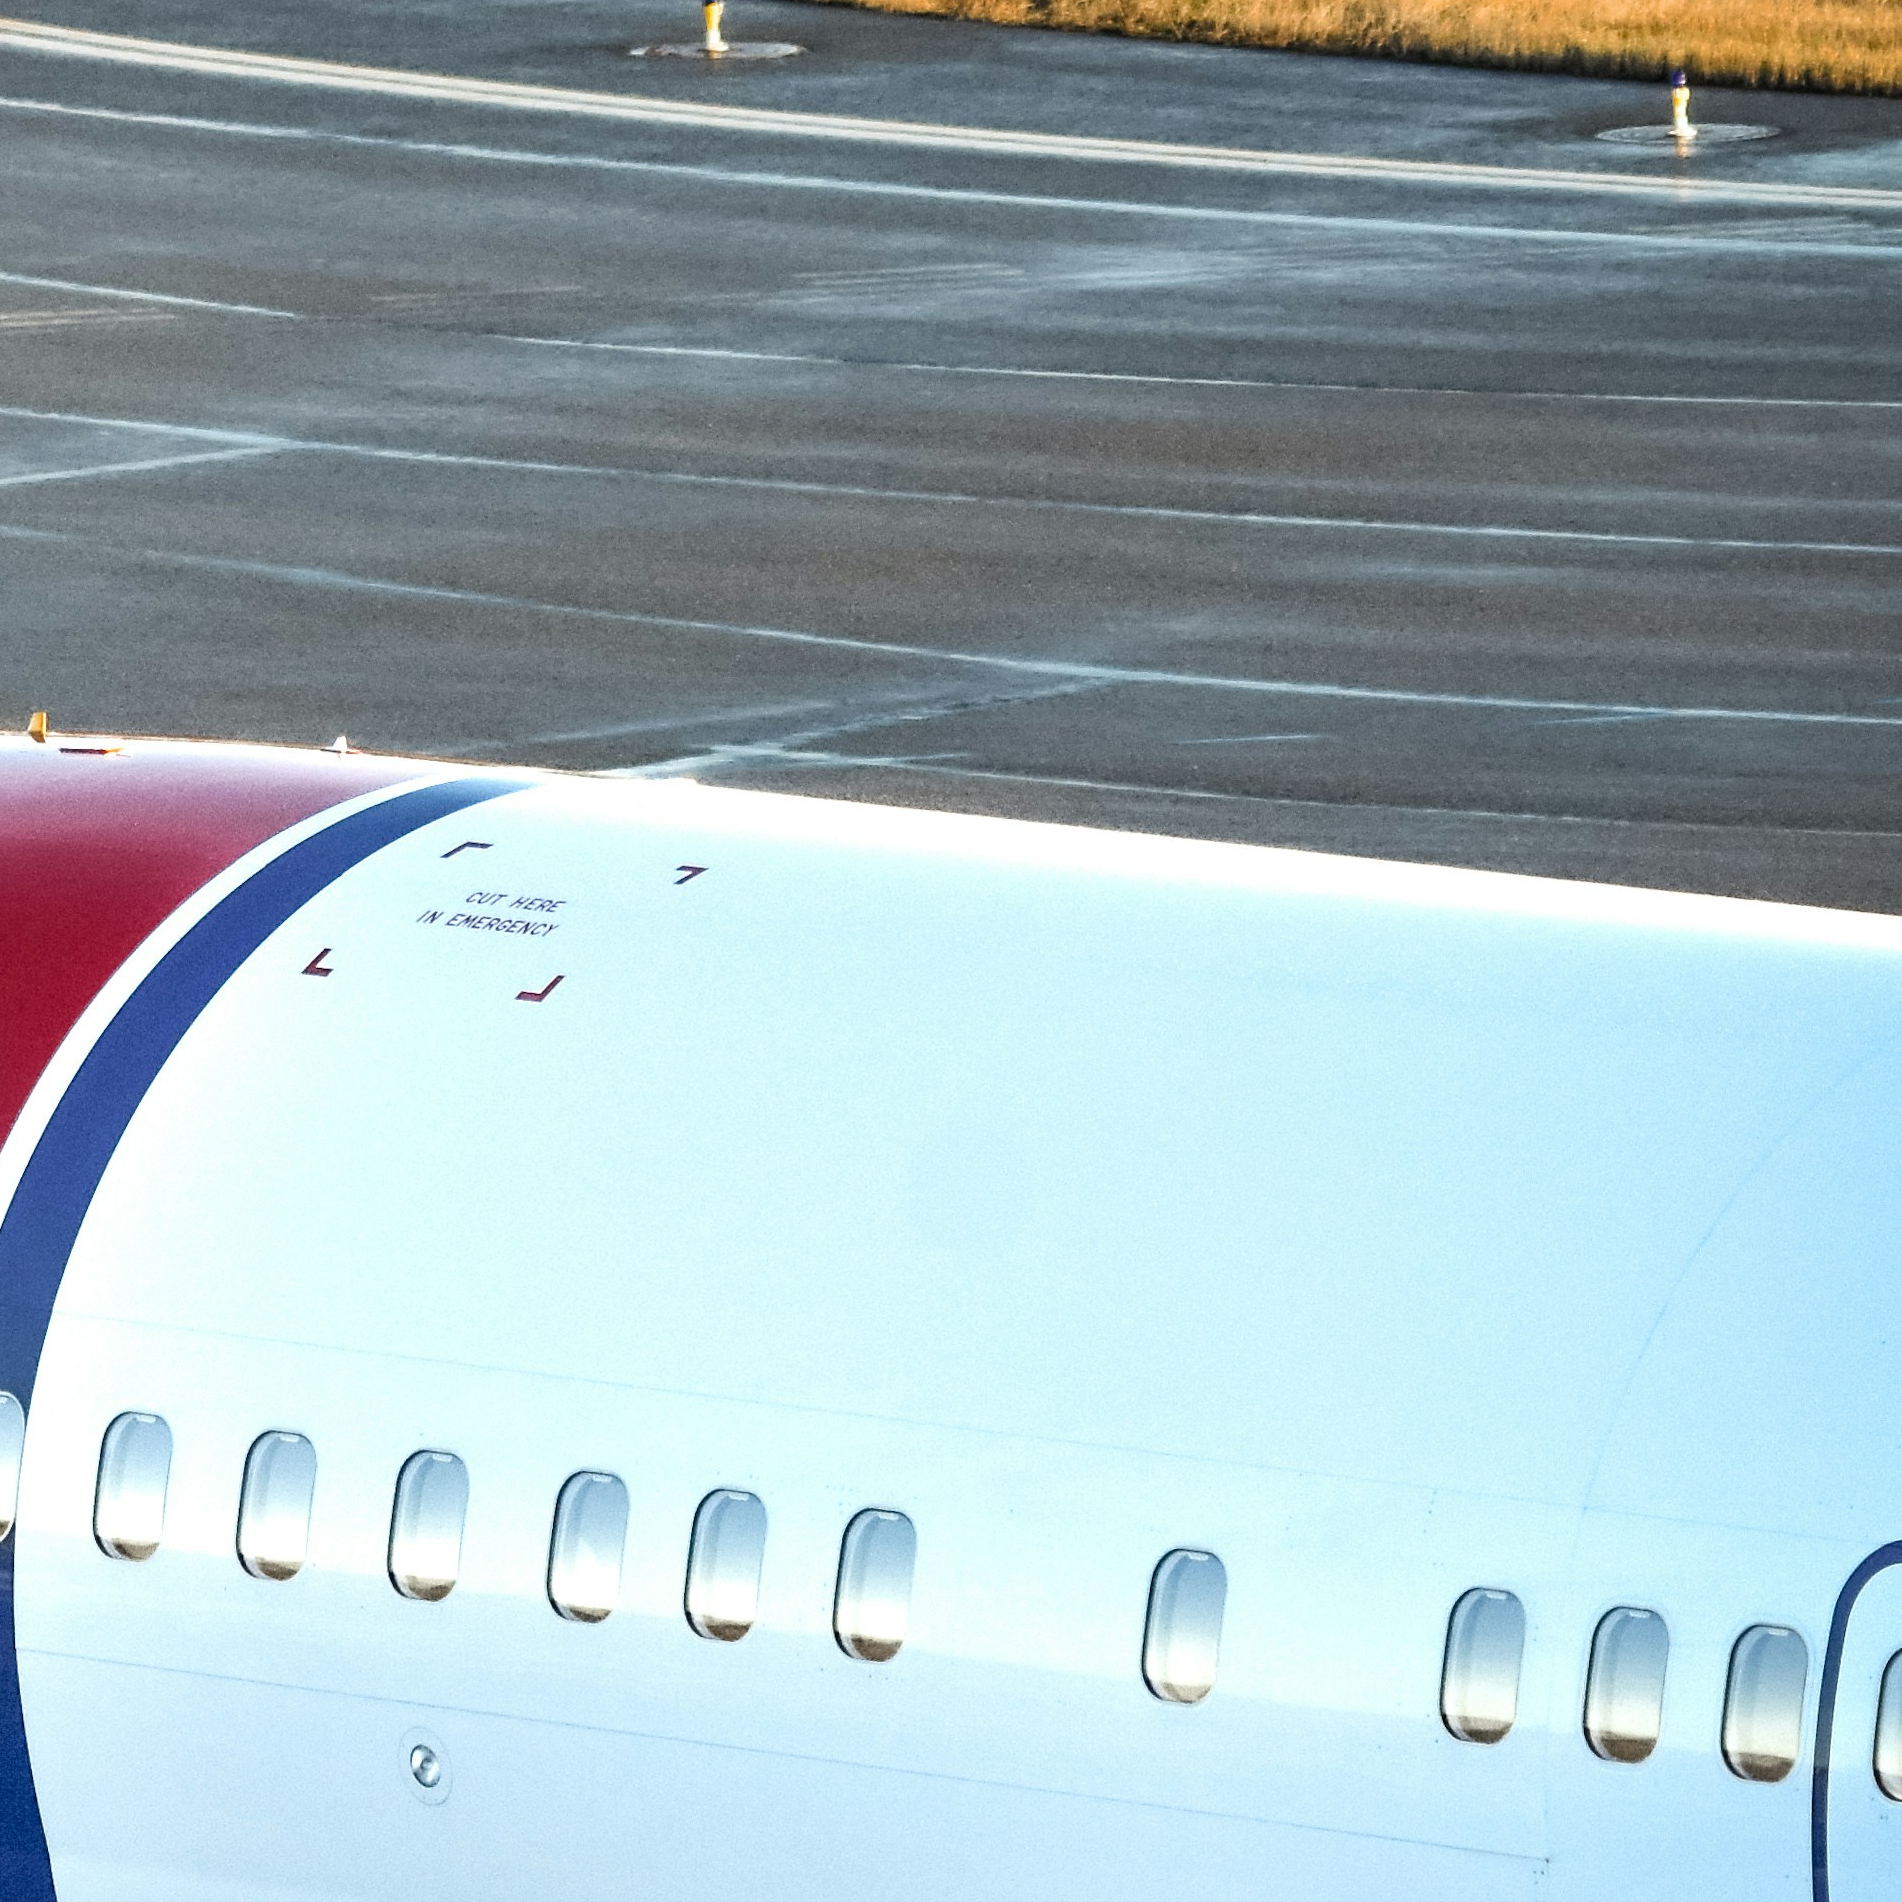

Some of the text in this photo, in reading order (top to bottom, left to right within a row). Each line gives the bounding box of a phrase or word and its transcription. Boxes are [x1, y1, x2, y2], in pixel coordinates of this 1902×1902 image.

[465, 891, 567, 913] CUT HERE
[415, 909, 560, 937] IN EMERGENCY
